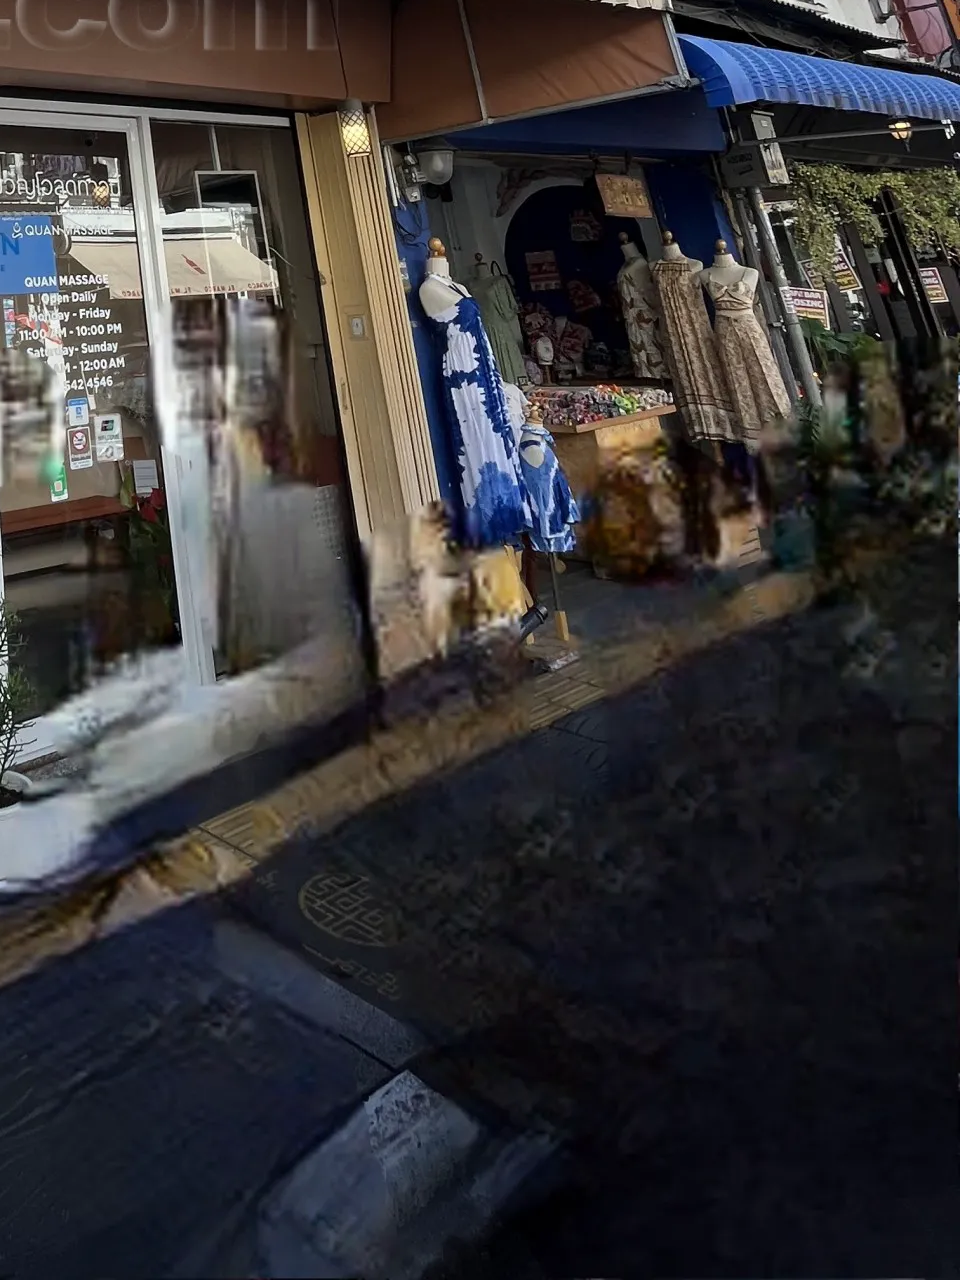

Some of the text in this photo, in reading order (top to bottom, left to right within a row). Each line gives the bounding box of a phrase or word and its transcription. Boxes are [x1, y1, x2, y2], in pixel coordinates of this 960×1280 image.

[25, 224, 114, 236] QUAN MASSAGE
[24, 274, 109, 288] QUAN MASSAGE
[41, 291, 97, 306] Open Daily
[29, 311, 70, 322] Monday
[79, 308, 111, 319] Friday
[19, 329, 46, 341] 11:00
[75, 325, 104, 336] 10:00
[107, 323, 123, 335] PM
[81, 341, 118, 354] Sunday
[79, 359, 108, 372] 12:00
[108, 357, 125, 369] AM
[86, 376, 113, 388] 4546
